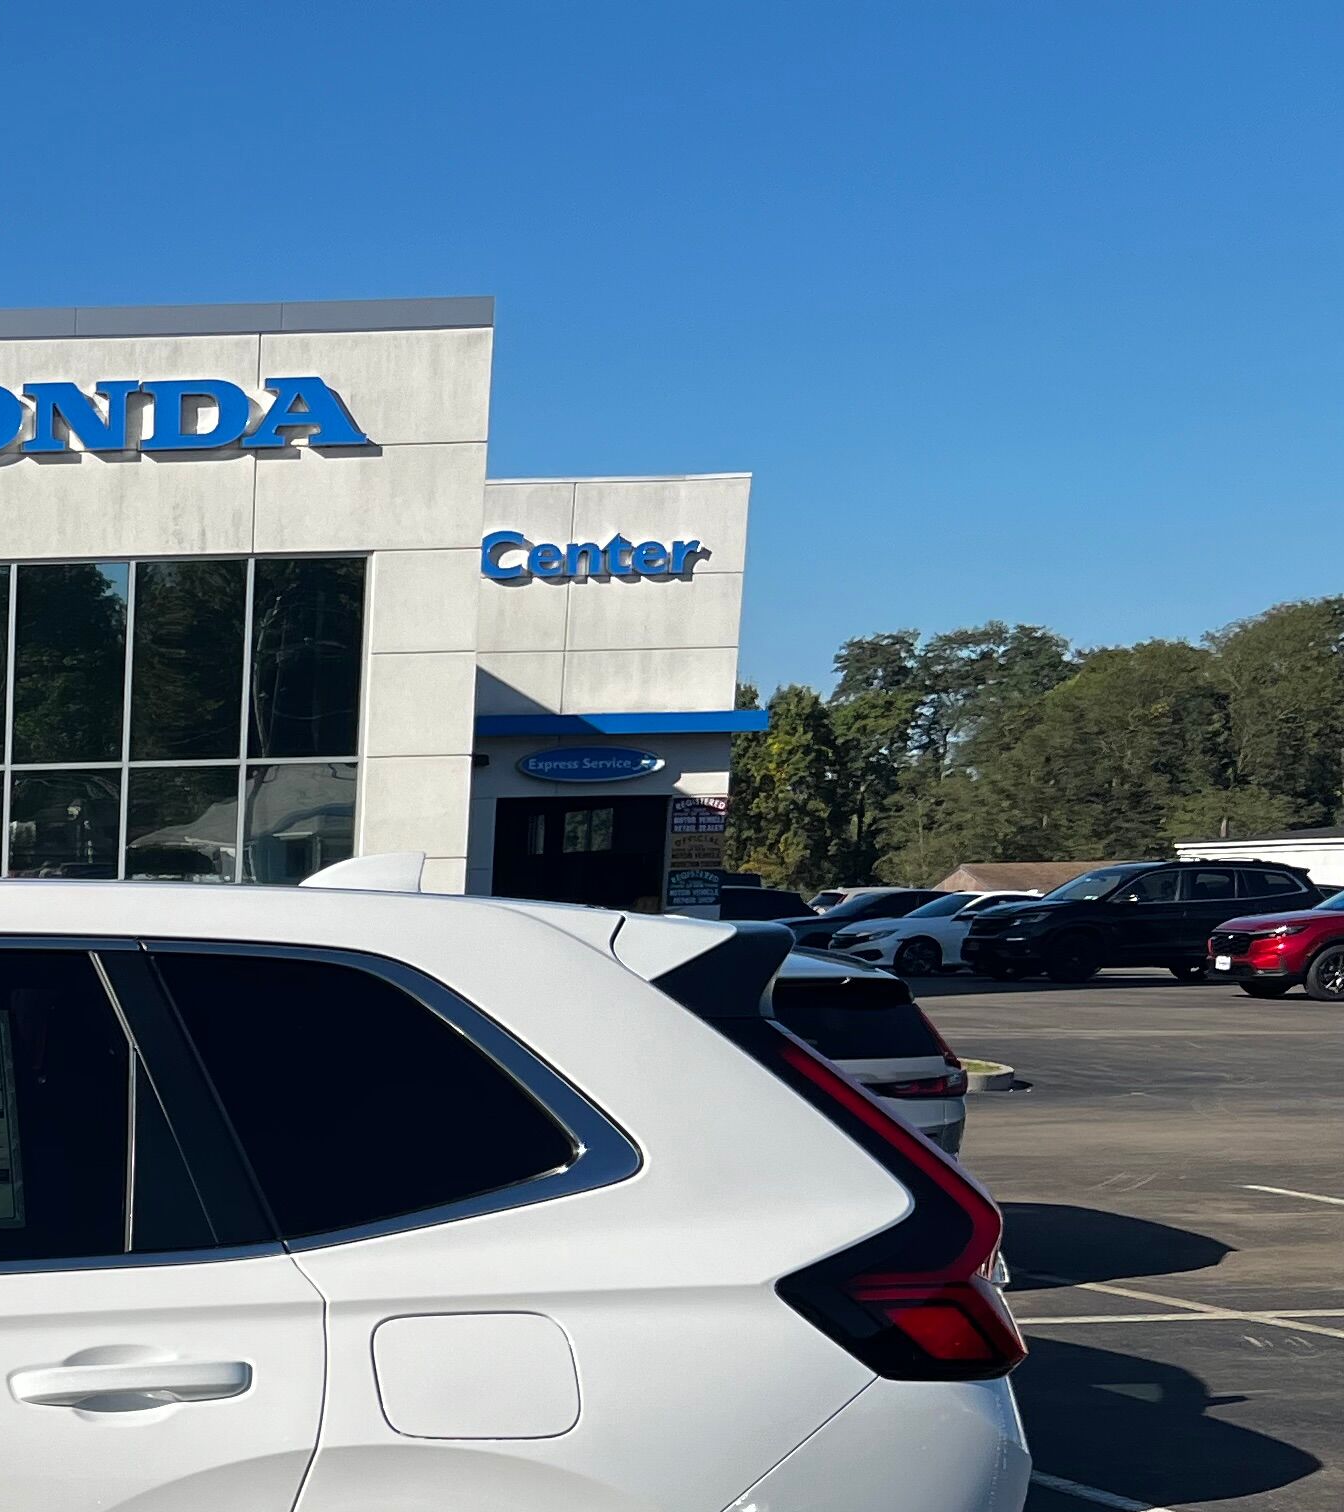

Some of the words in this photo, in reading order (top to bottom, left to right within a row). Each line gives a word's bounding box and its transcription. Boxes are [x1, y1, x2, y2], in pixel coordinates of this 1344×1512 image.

[481, 530, 701, 579] Center
[528, 758, 579, 772] Express
[582, 757, 632, 769] Service
[675, 798, 726, 810] REGISTERED
